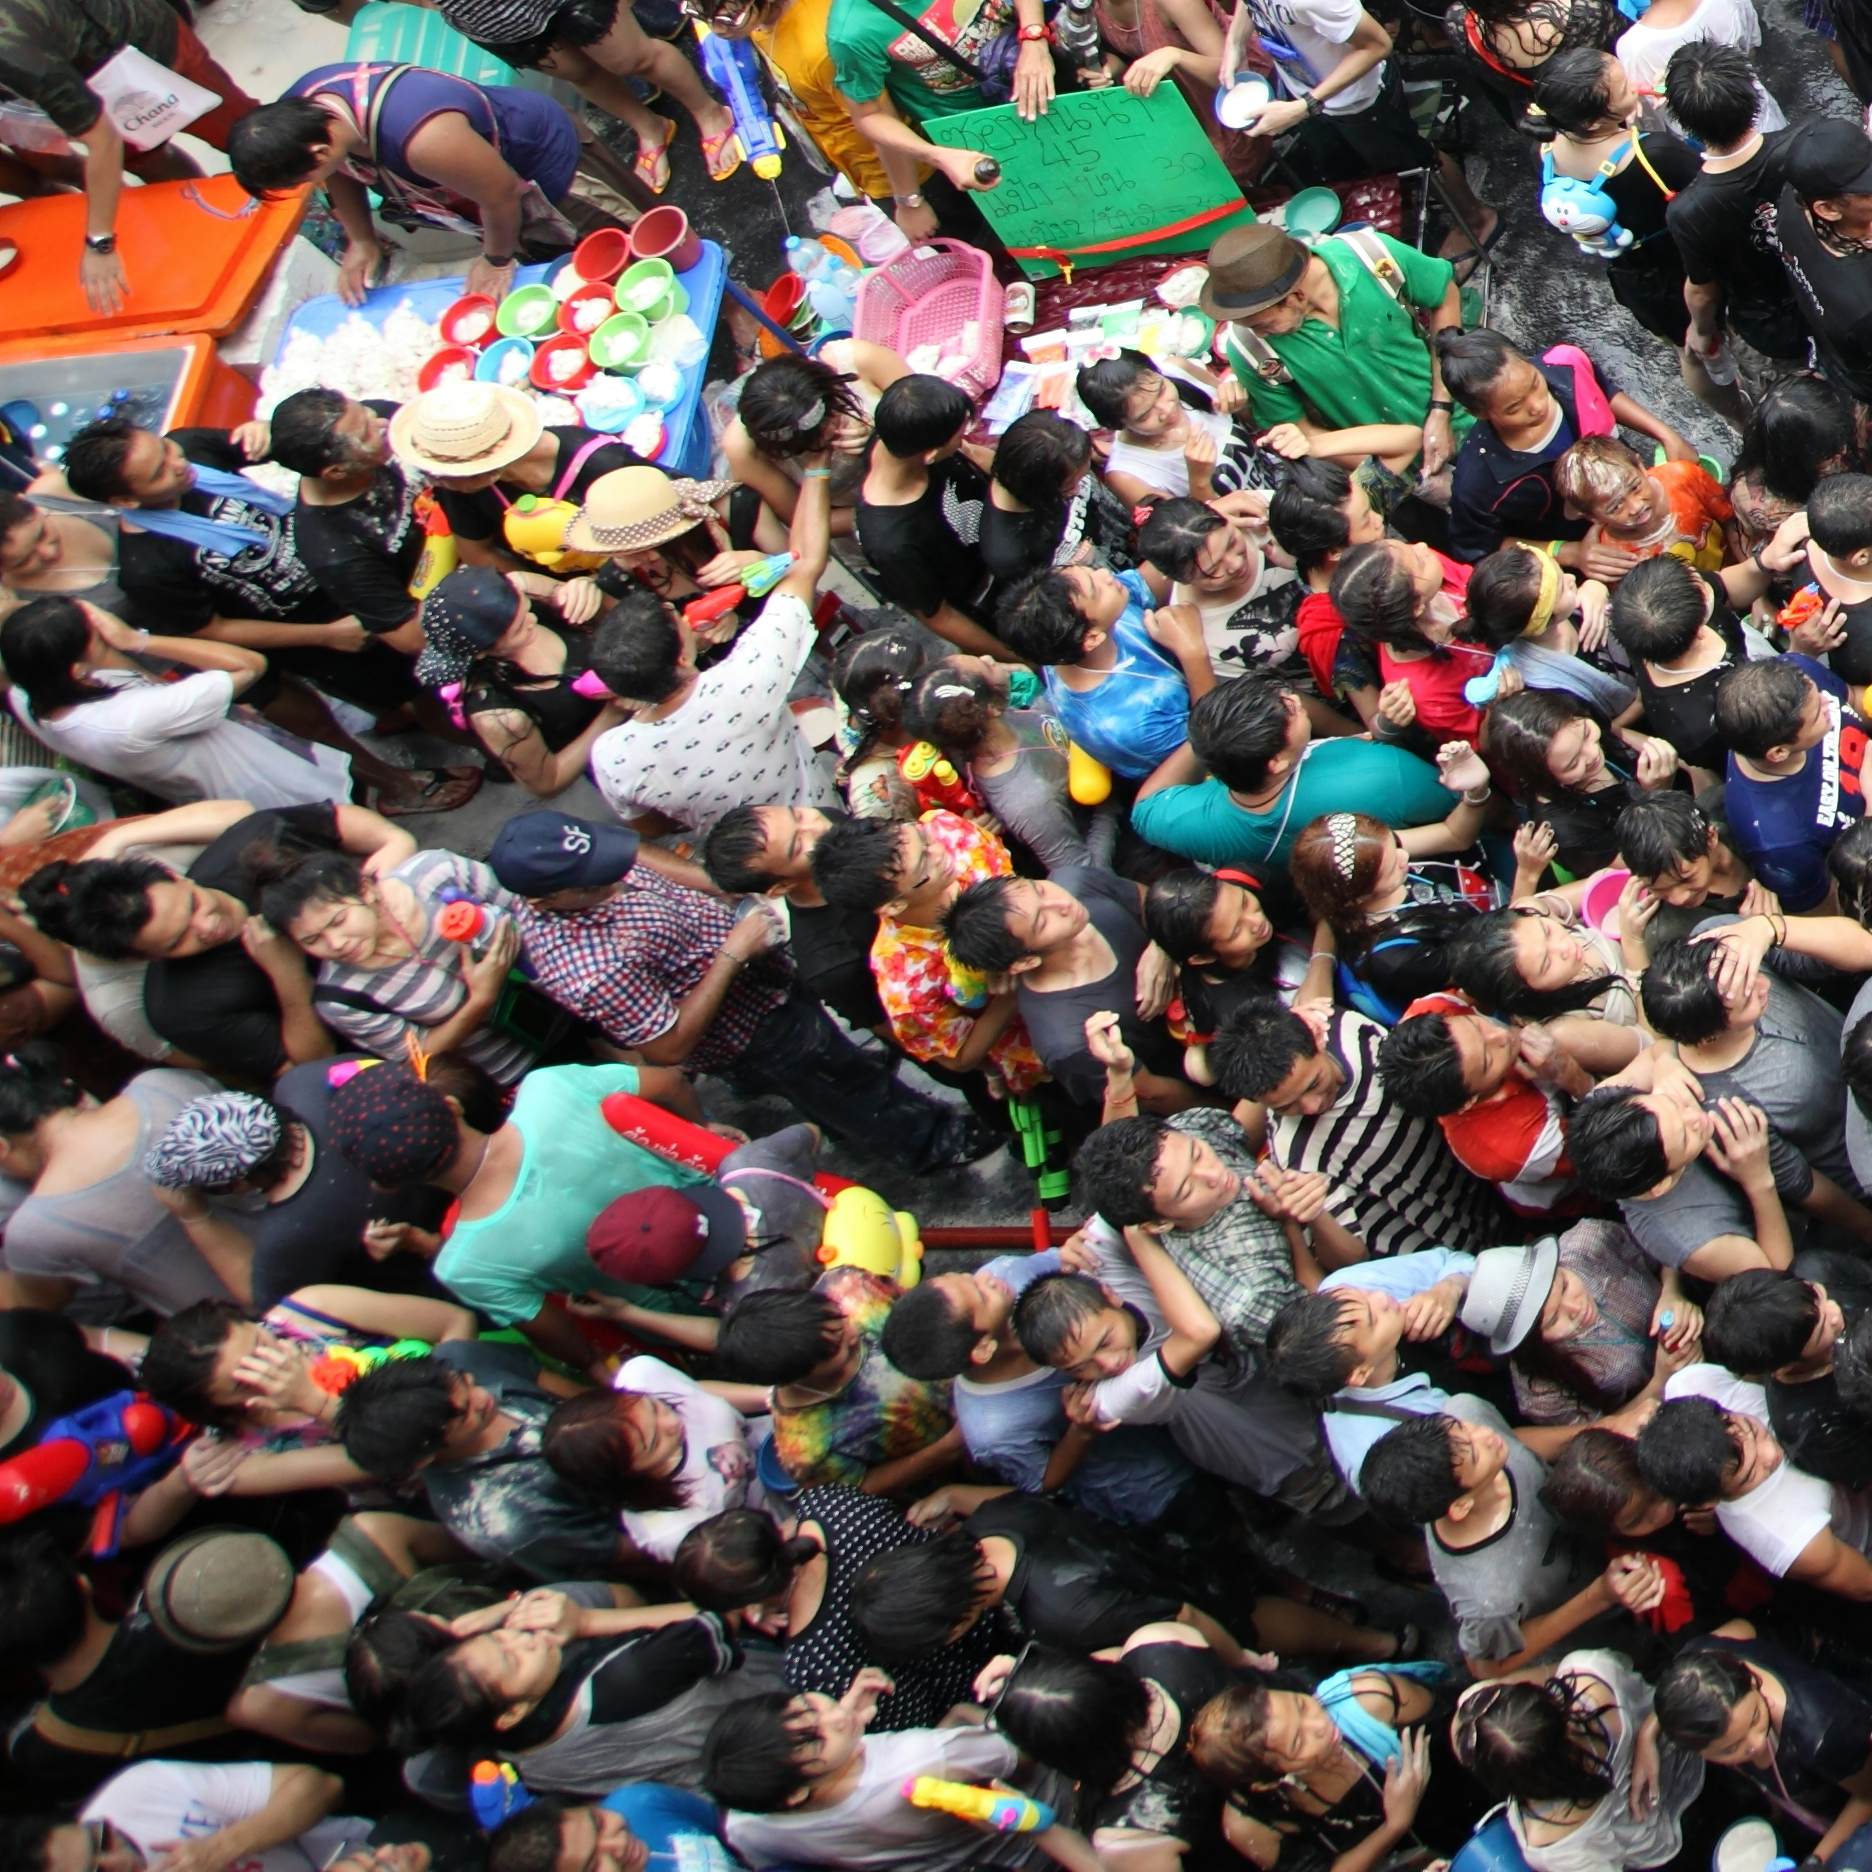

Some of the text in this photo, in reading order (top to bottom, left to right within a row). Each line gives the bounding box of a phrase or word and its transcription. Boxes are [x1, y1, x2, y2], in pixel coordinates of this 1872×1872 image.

[1041, 134, 1101, 168] 45
[1821, 758, 1839, 784] ON
[1816, 785, 1838, 828] EASY
[563, 824, 592, 855] SF
